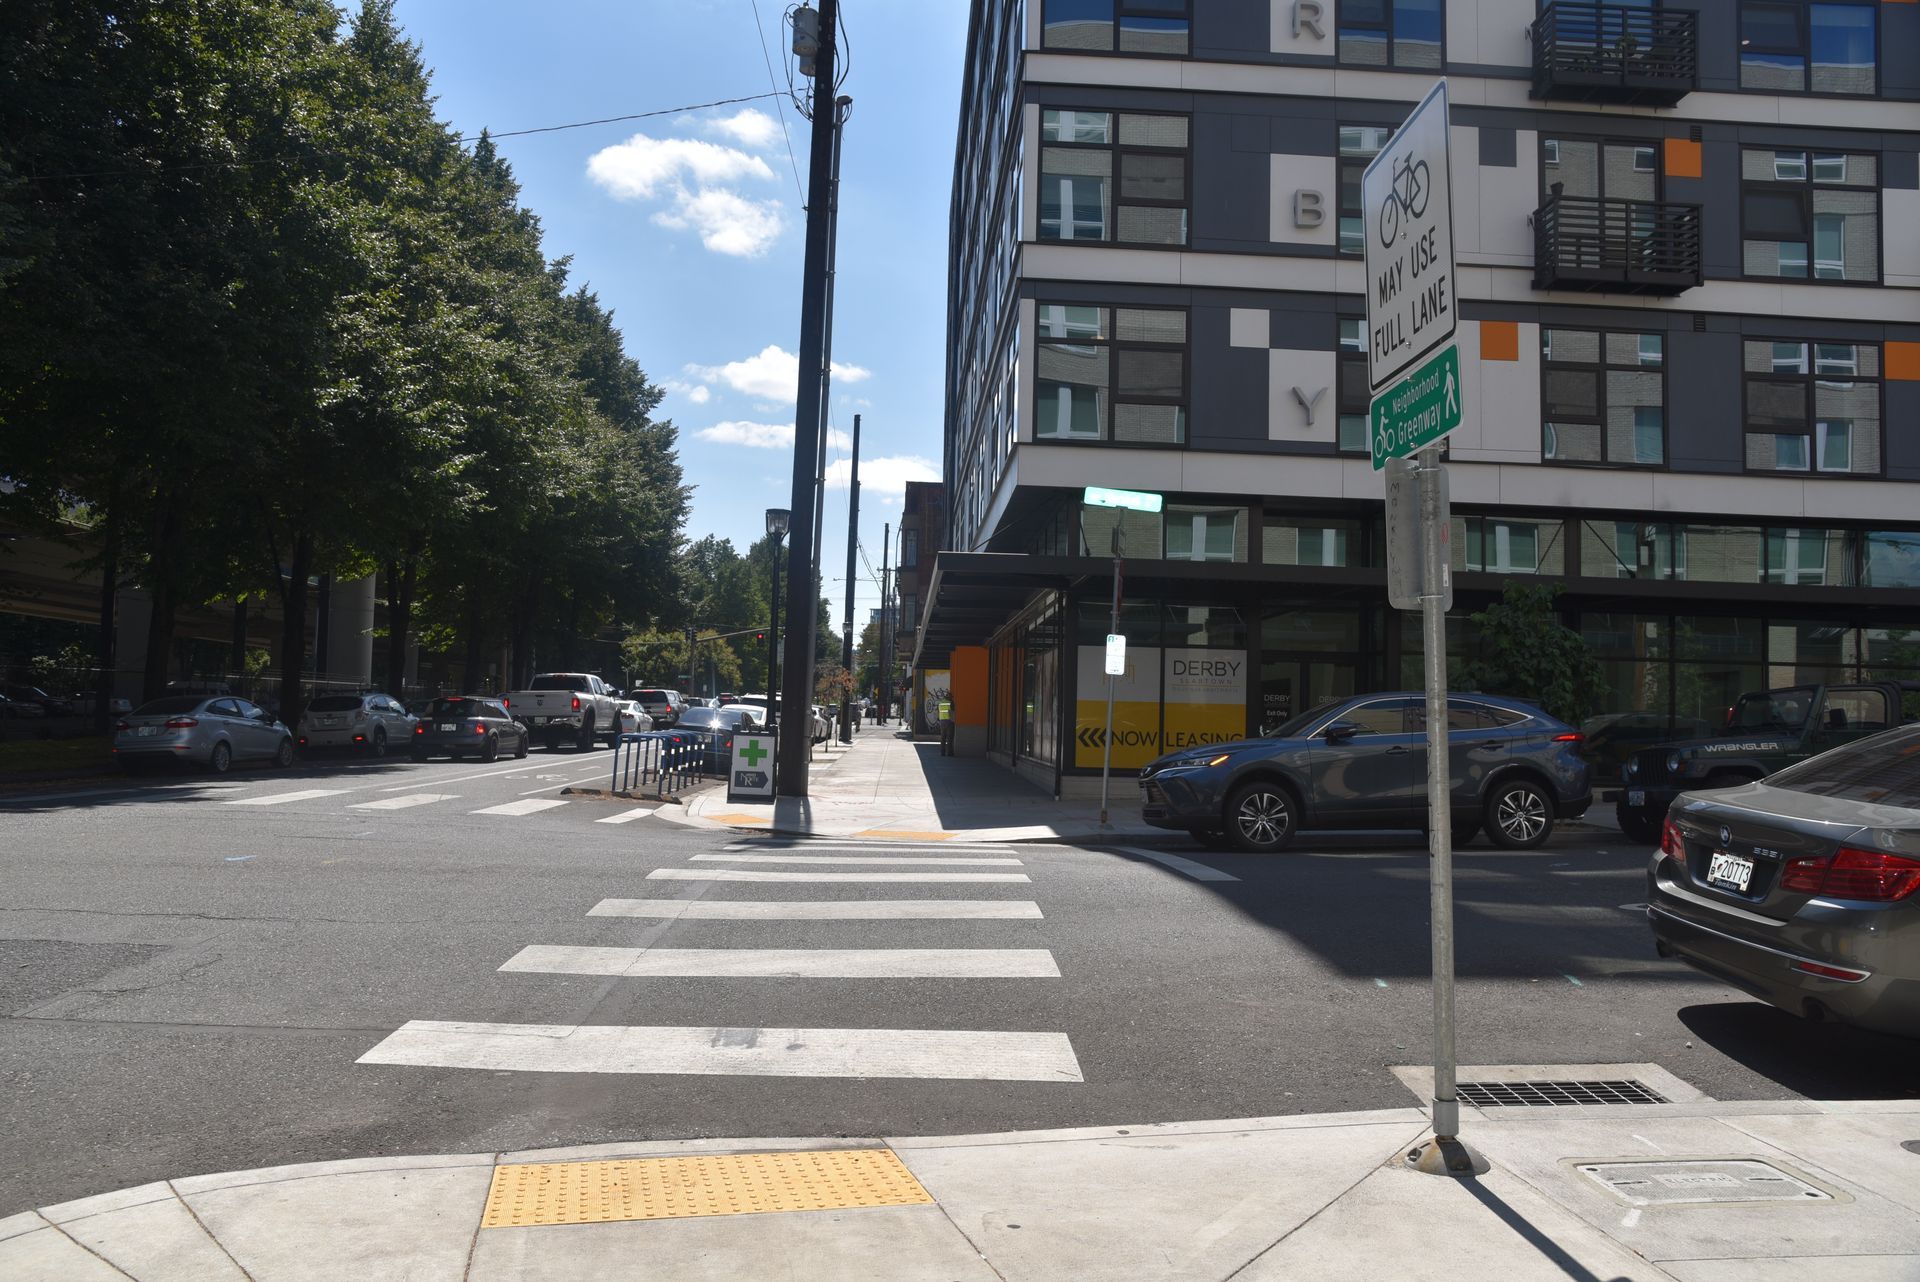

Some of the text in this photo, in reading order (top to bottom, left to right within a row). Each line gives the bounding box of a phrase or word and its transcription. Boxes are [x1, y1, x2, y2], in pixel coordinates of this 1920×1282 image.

[1378, 224, 1438, 308] MAY USE
[1374, 274, 1448, 363] FULL LANE
[1392, 368, 1440, 416] Neighborhood
[1398, 402, 1441, 445] Greenway
[1173, 660, 1241, 677] DERBY
[1276, 710, 1288, 718] Only
[1111, 730, 1158, 747] NOW
[1704, 743, 1778, 752] WRANGLER
[1720, 860, 1752, 884] 20773
